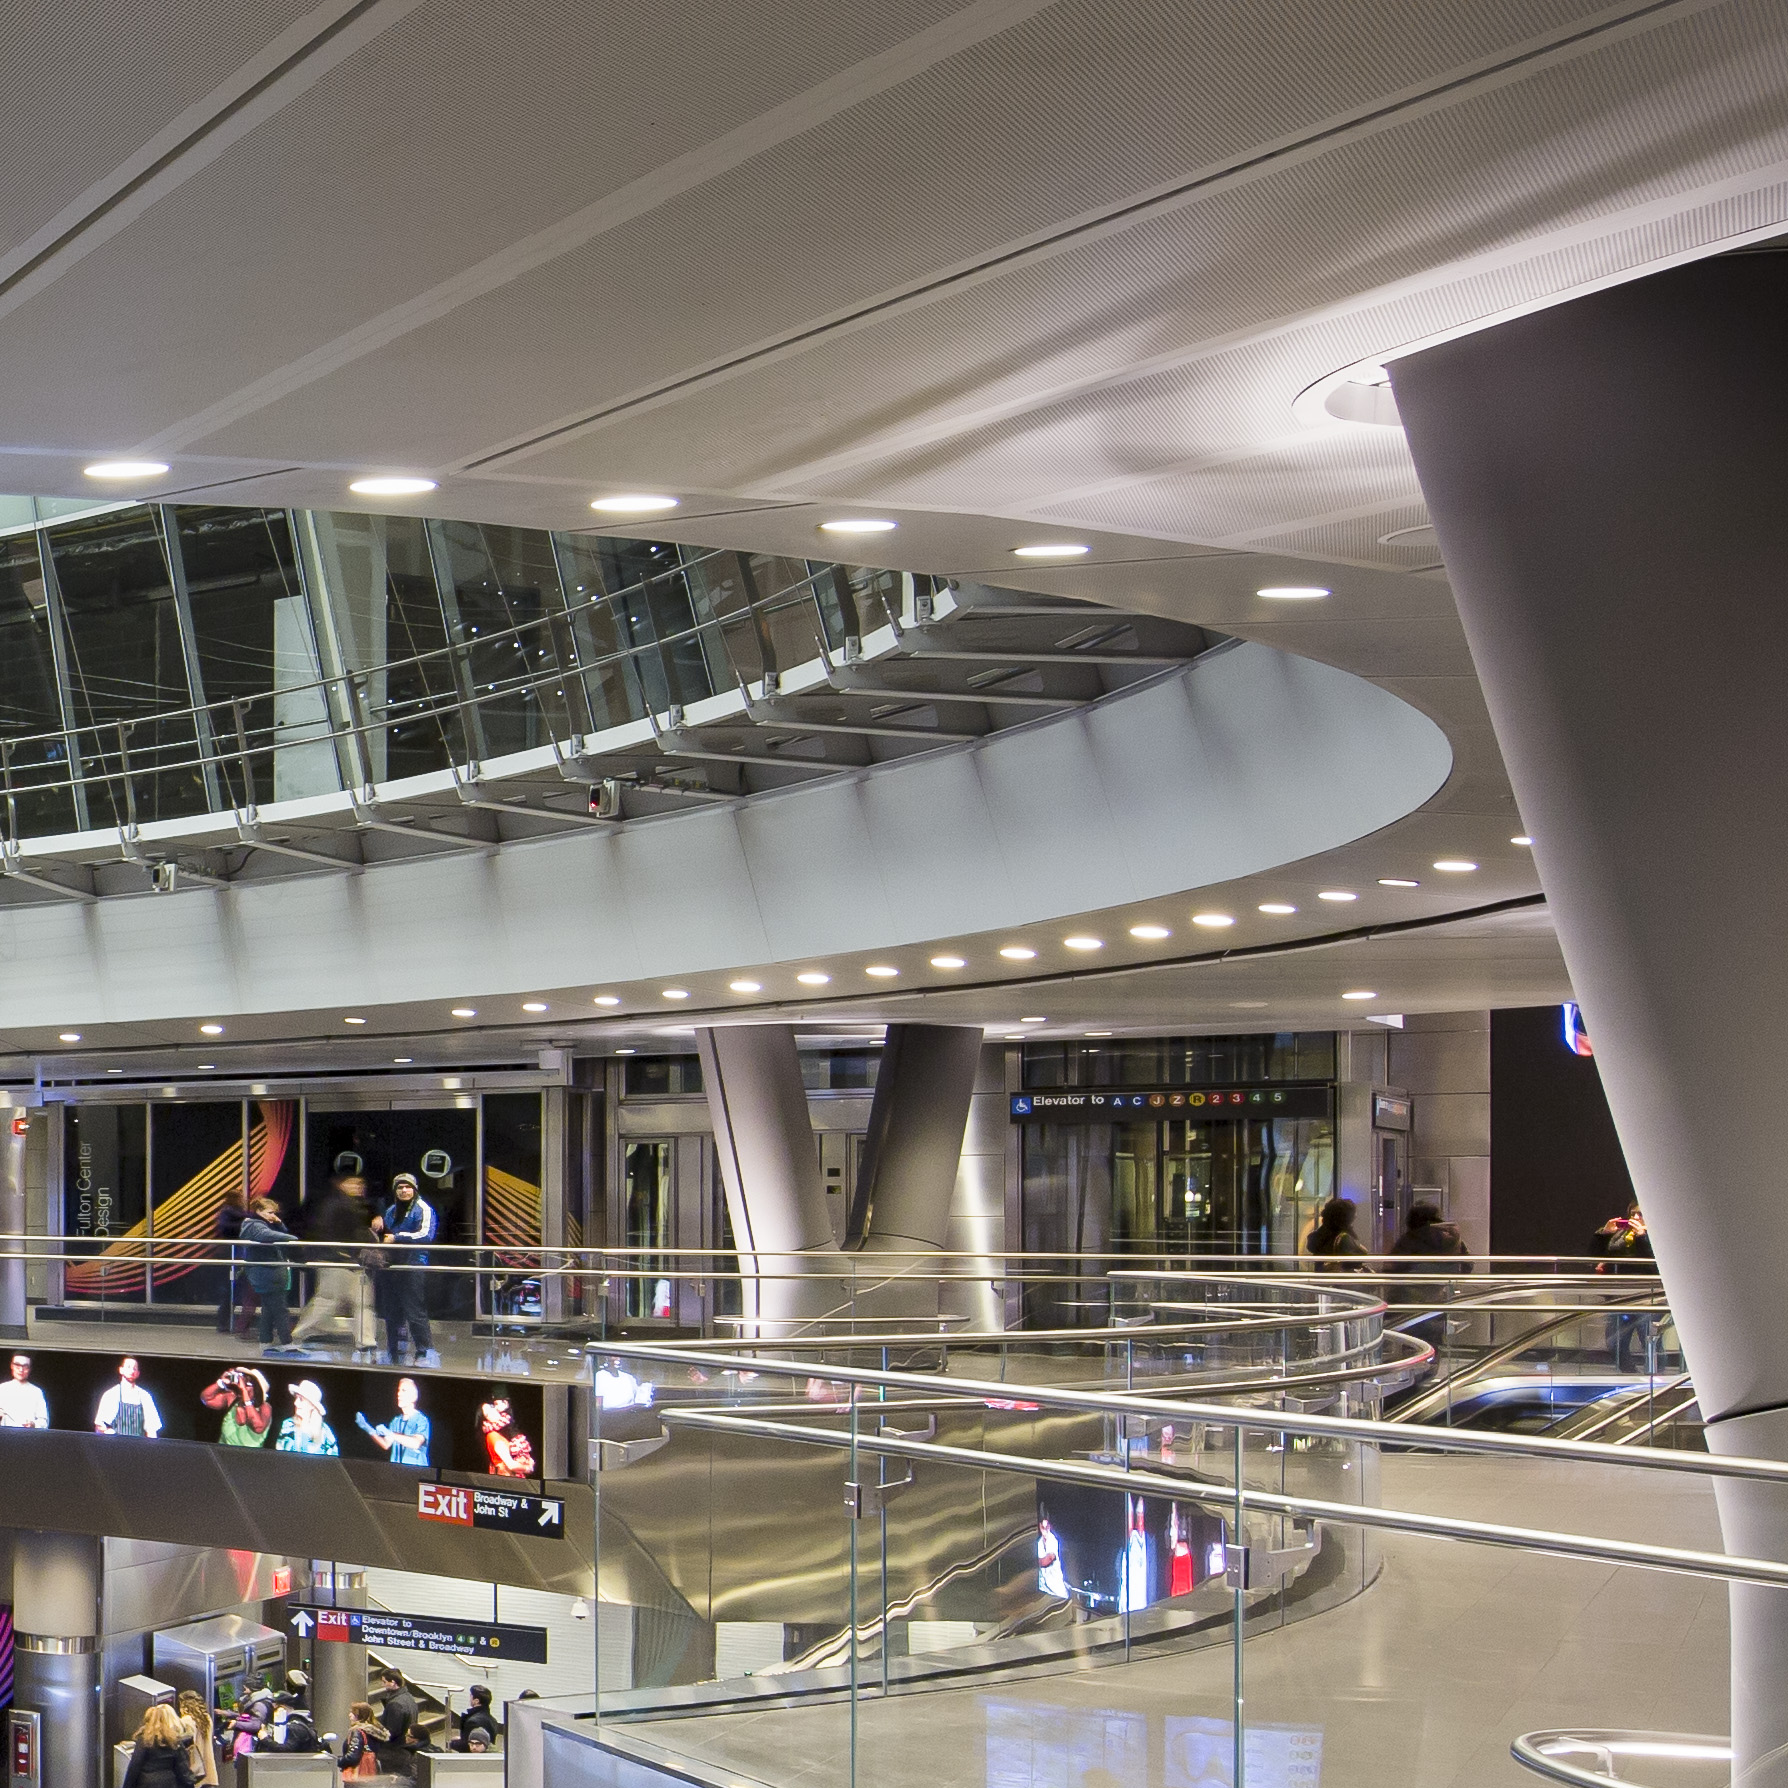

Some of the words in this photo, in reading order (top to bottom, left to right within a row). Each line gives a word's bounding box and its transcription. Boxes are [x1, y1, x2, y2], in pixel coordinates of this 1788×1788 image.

[1032, 1094, 1085, 1106] Elevator
[1091, 1094, 1105, 1105] to
[76, 1141, 92, 1191] Center
[94, 1187, 113, 1237] Design
[419, 1484, 467, 1520] Exit
[474, 1492, 518, 1509] Broadway
[520, 1498, 529, 1509] &
[474, 1503, 496, 1516] John
[497, 1506, 510, 1518] St
[317, 1611, 347, 1626] Exit
[362, 1615, 399, 1627] Elevator
[402, 1619, 413, 1628] to
[361, 1634, 384, 1645] John
[387, 1636, 415, 1648] Street
[418, 1639, 426, 1649] &
[429, 1643, 475, 1655] Broadway
[479, 1637, 487, 1646] &
